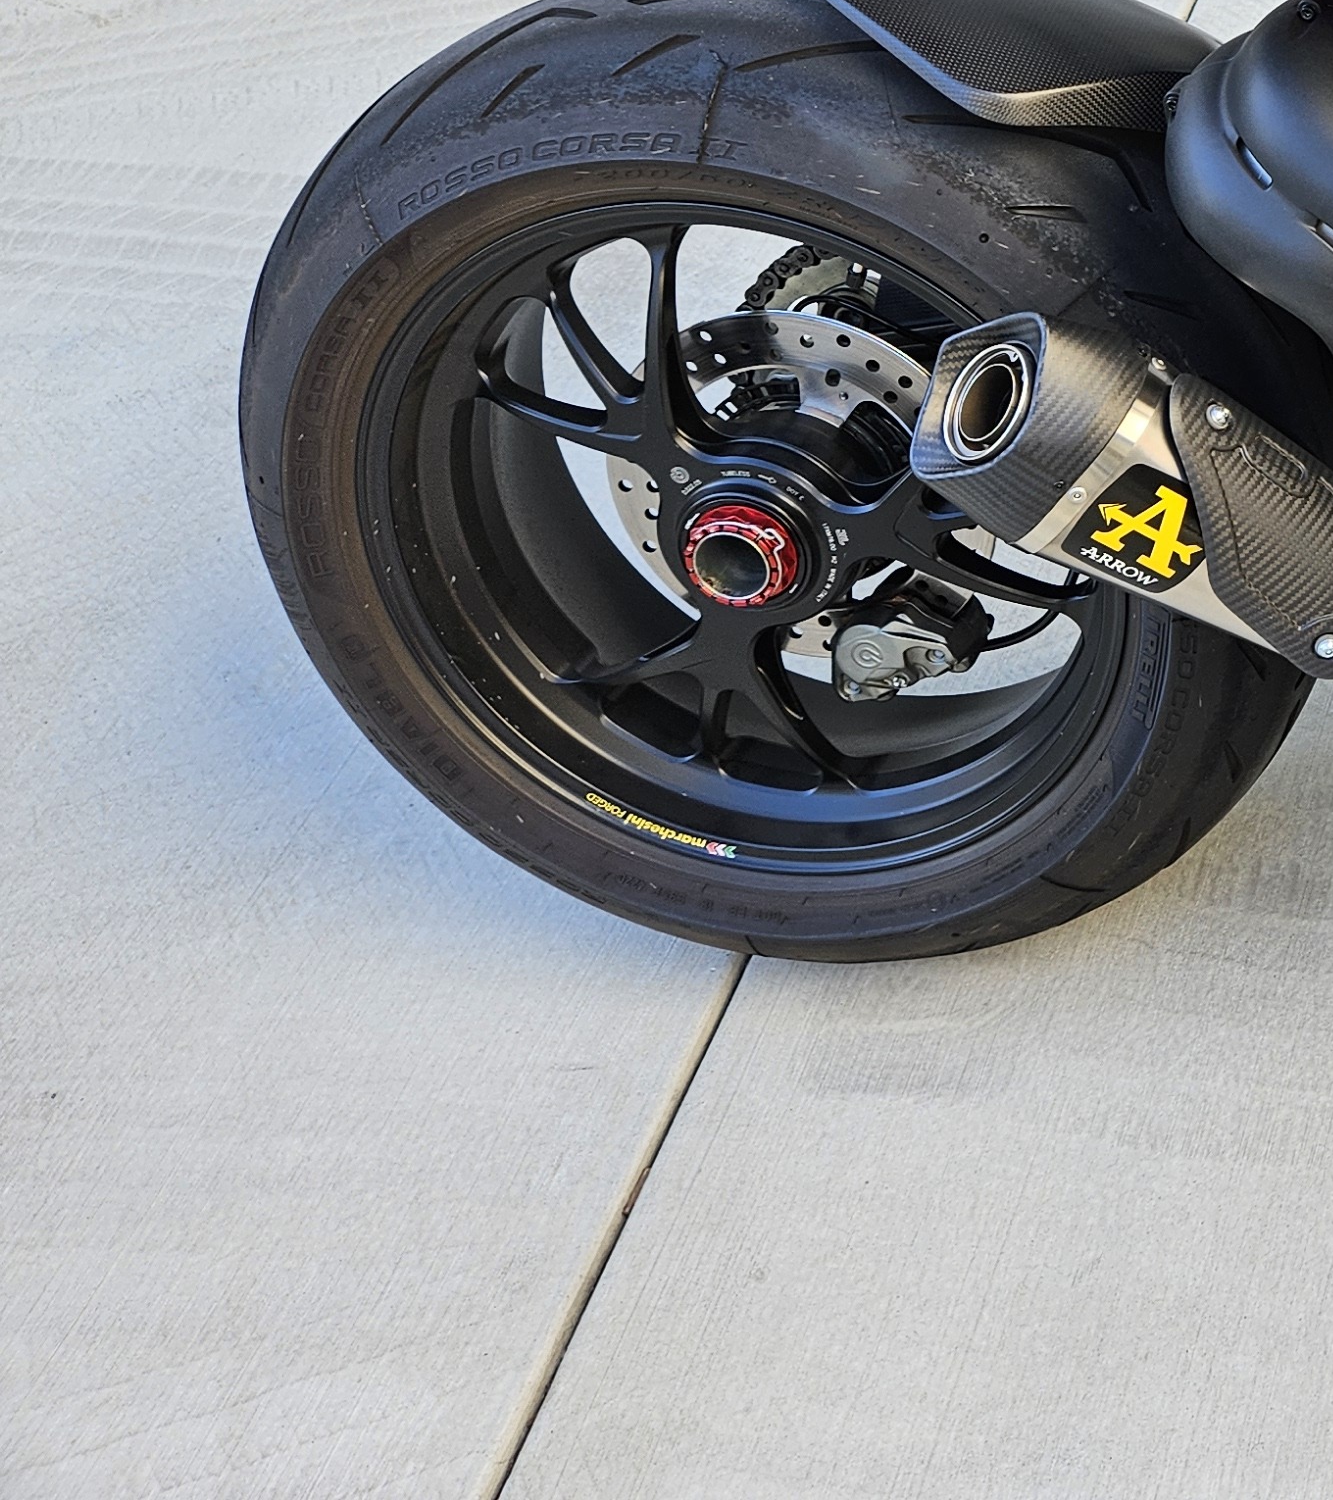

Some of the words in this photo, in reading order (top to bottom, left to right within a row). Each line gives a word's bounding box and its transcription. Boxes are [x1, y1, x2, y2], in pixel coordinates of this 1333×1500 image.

[398, 146, 523, 221] ROSSO
[531, 132, 683, 164] CORSA
[1080, 546, 1159, 586] ARROW
[586, 792, 627, 819] FORGED
[623, 813, 707, 848] marchesini
